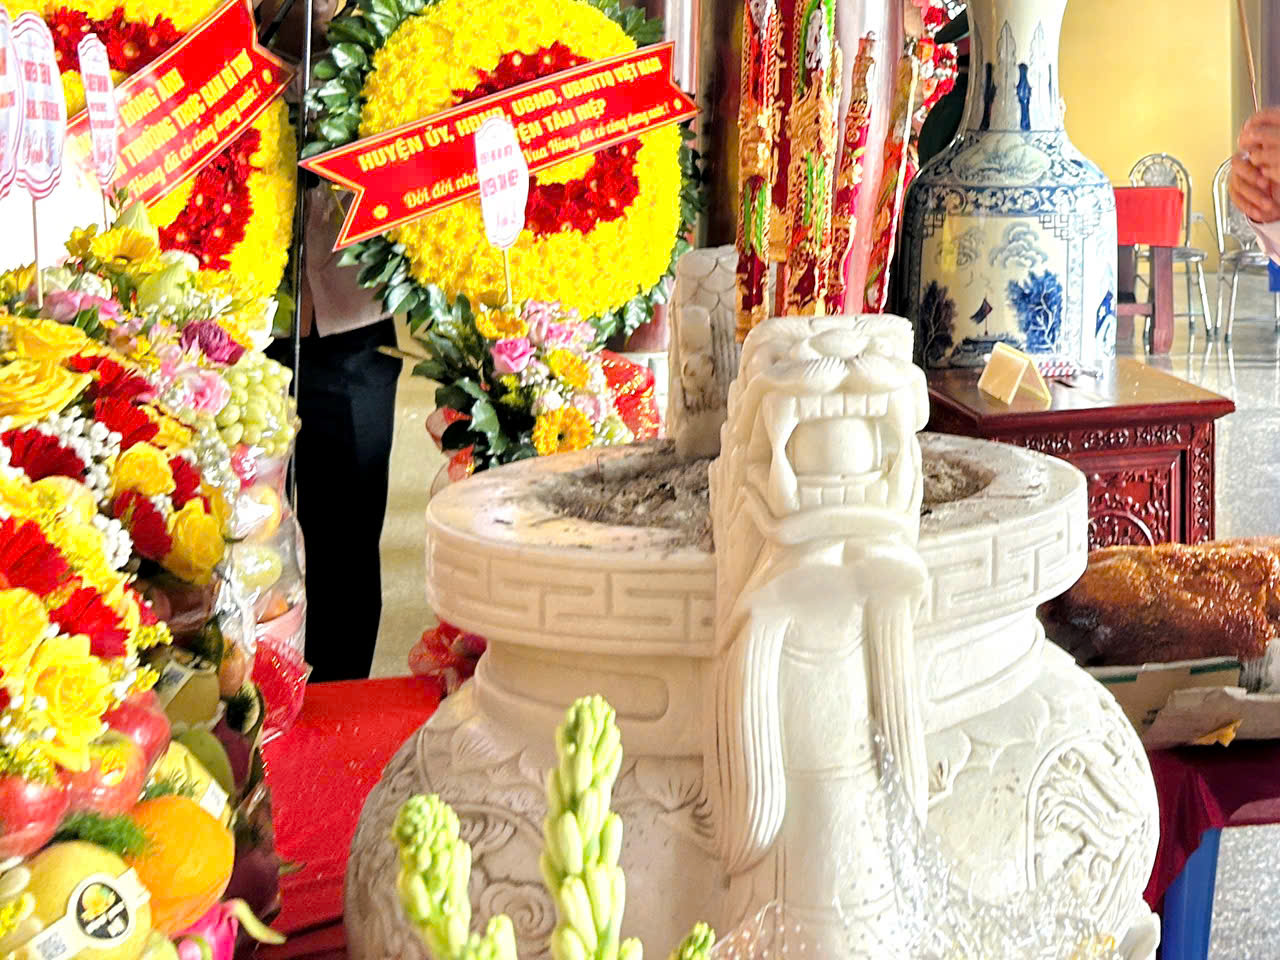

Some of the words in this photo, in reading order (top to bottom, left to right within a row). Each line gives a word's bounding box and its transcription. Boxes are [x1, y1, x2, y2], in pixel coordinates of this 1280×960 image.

[358, 135, 424, 171] HUYỆN
[512, 89, 563, 117] UBND,
[542, 109, 576, 133] TÂN
[575, 98, 607, 122] HIỆP
